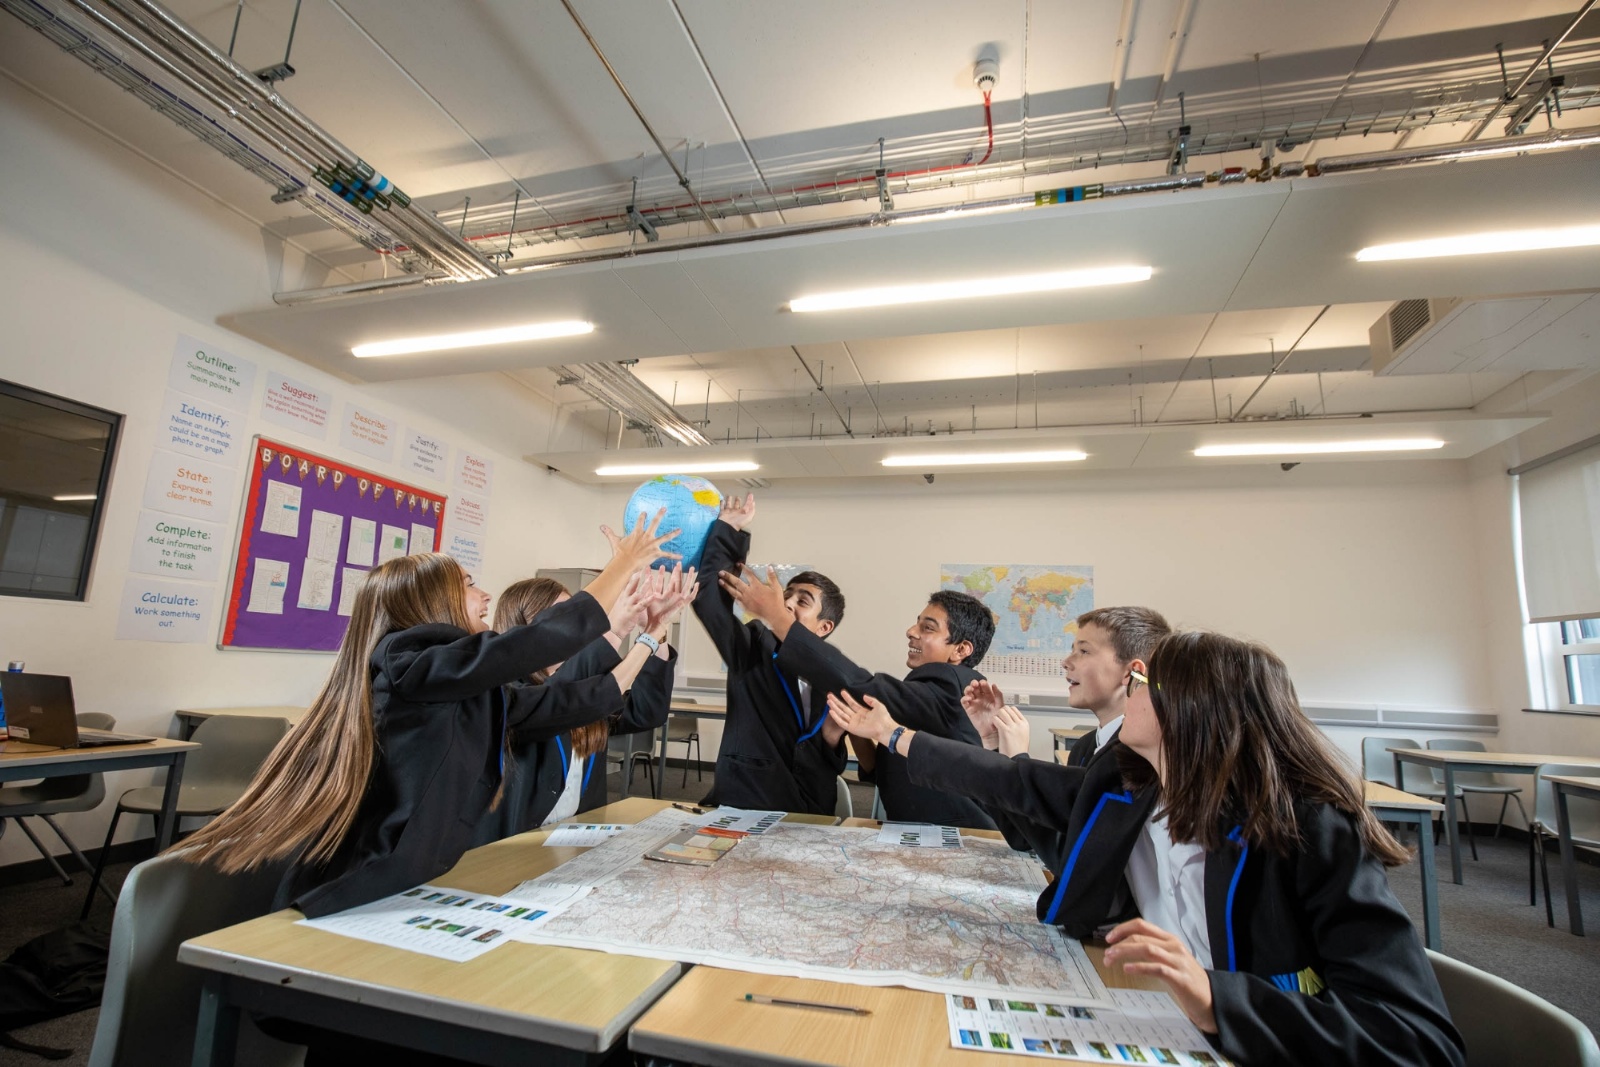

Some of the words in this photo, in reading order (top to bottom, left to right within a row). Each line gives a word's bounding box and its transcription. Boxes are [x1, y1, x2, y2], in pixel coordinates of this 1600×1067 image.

[196, 350, 237, 373] Outline:
[187, 361, 227, 381] Summarise
[229, 376, 241, 387] the
[190, 373, 208, 384] main
[209, 378, 233, 394] points.
[281, 382, 319, 402] Suggest:
[180, 403, 229, 428] Identify:
[355, 411, 387, 431] Describe:
[171, 415, 193, 427] Name
[194, 422, 203, 430] an
[204, 425, 232, 440] example.
[169, 424, 189, 436] could
[191, 430, 199, 439] be
[201, 434, 210, 442] on
[216, 439, 231, 450] map.
[172, 435, 194, 447] photo
[195, 440, 203, 448] or
[204, 442, 225, 456] graph.
[416, 435, 440, 452] Justify:
[176, 468, 212, 484] State:
[262, 448, 343, 483] BOARD
[360, 479, 382, 494] OF
[395, 490, 441, 513] FAME
[171, 480, 203, 495] Express
[205, 488, 212, 496] in
[166, 490, 187, 501] clear
[189, 494, 213, 507] terms.
[155, 522, 212, 540] Complete:
[147, 535, 165, 545] Add
[166, 538, 212, 552] information
[161, 548, 171, 557] to
[173, 549, 196, 560] finish
[159, 559, 173, 569] the
[175, 561, 195, 571] task.
[141, 592, 199, 607] Calculate:
[134, 606, 158, 616] Work
[160, 609, 201, 621] something
[158, 619, 175, 628] out.
